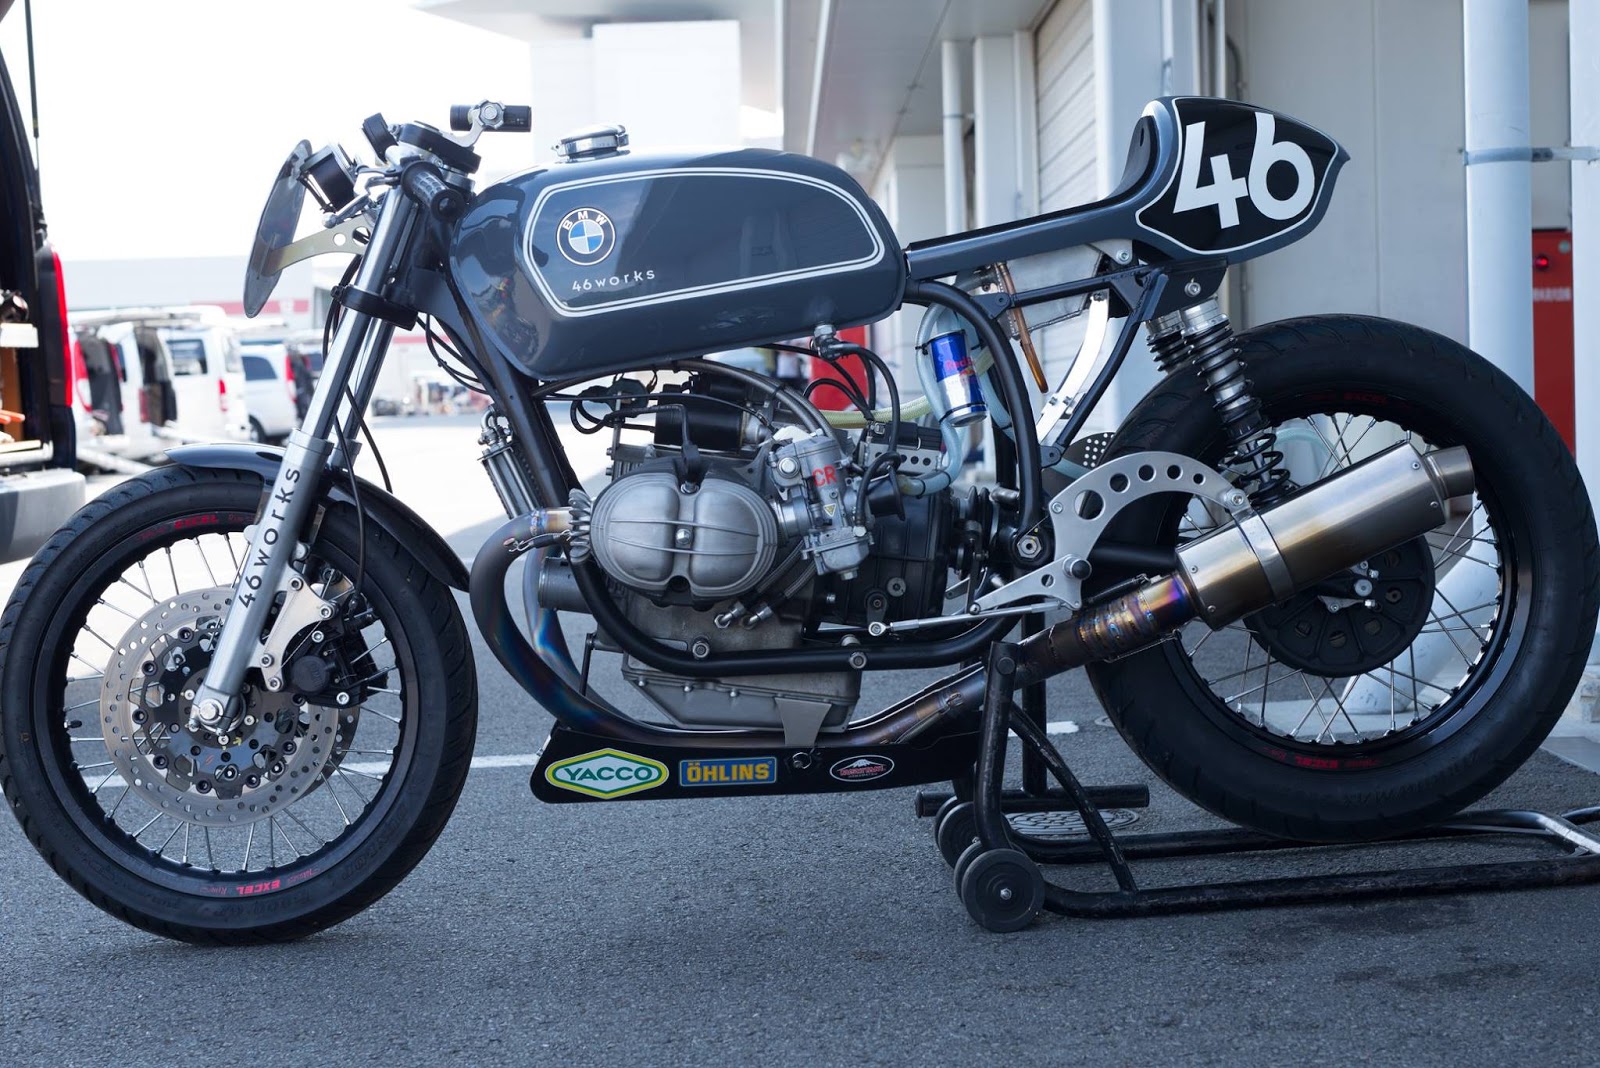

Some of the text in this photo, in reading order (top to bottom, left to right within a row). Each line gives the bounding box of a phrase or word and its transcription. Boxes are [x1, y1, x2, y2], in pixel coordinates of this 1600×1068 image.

[1173, 112, 1315, 230] 46
[562, 210, 608, 231] BMW
[572, 269, 656, 292] 46works
[812, 464, 837, 487] CR
[238, 468, 301, 609] 46works
[564, 766, 652, 782] YACCO
[686, 761, 770, 783] ÖHLINS
[236, 879, 281, 895] EXCEL
